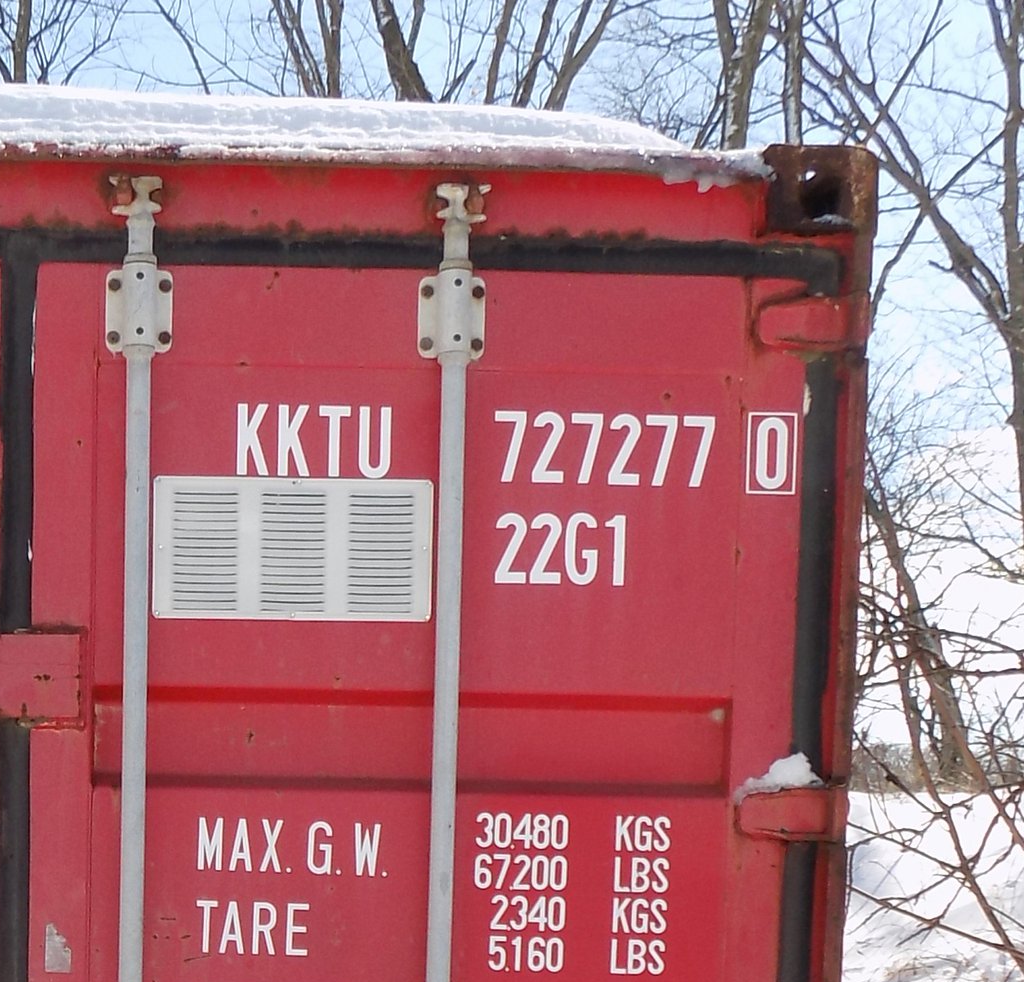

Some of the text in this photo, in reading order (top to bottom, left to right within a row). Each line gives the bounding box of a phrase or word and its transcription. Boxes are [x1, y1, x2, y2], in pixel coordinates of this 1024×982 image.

[236, 402, 791, 490] KKTU 727277 0
[494, 511, 627, 587] 22G1
[197, 816, 292, 873] MAX.
[614, 815, 671, 852] KGS
[613, 856, 670, 893] LBS
[196, 899, 310, 957] TARE
[611, 897, 668, 934] KGS
[488, 935, 666, 975] 5.160 LBS
